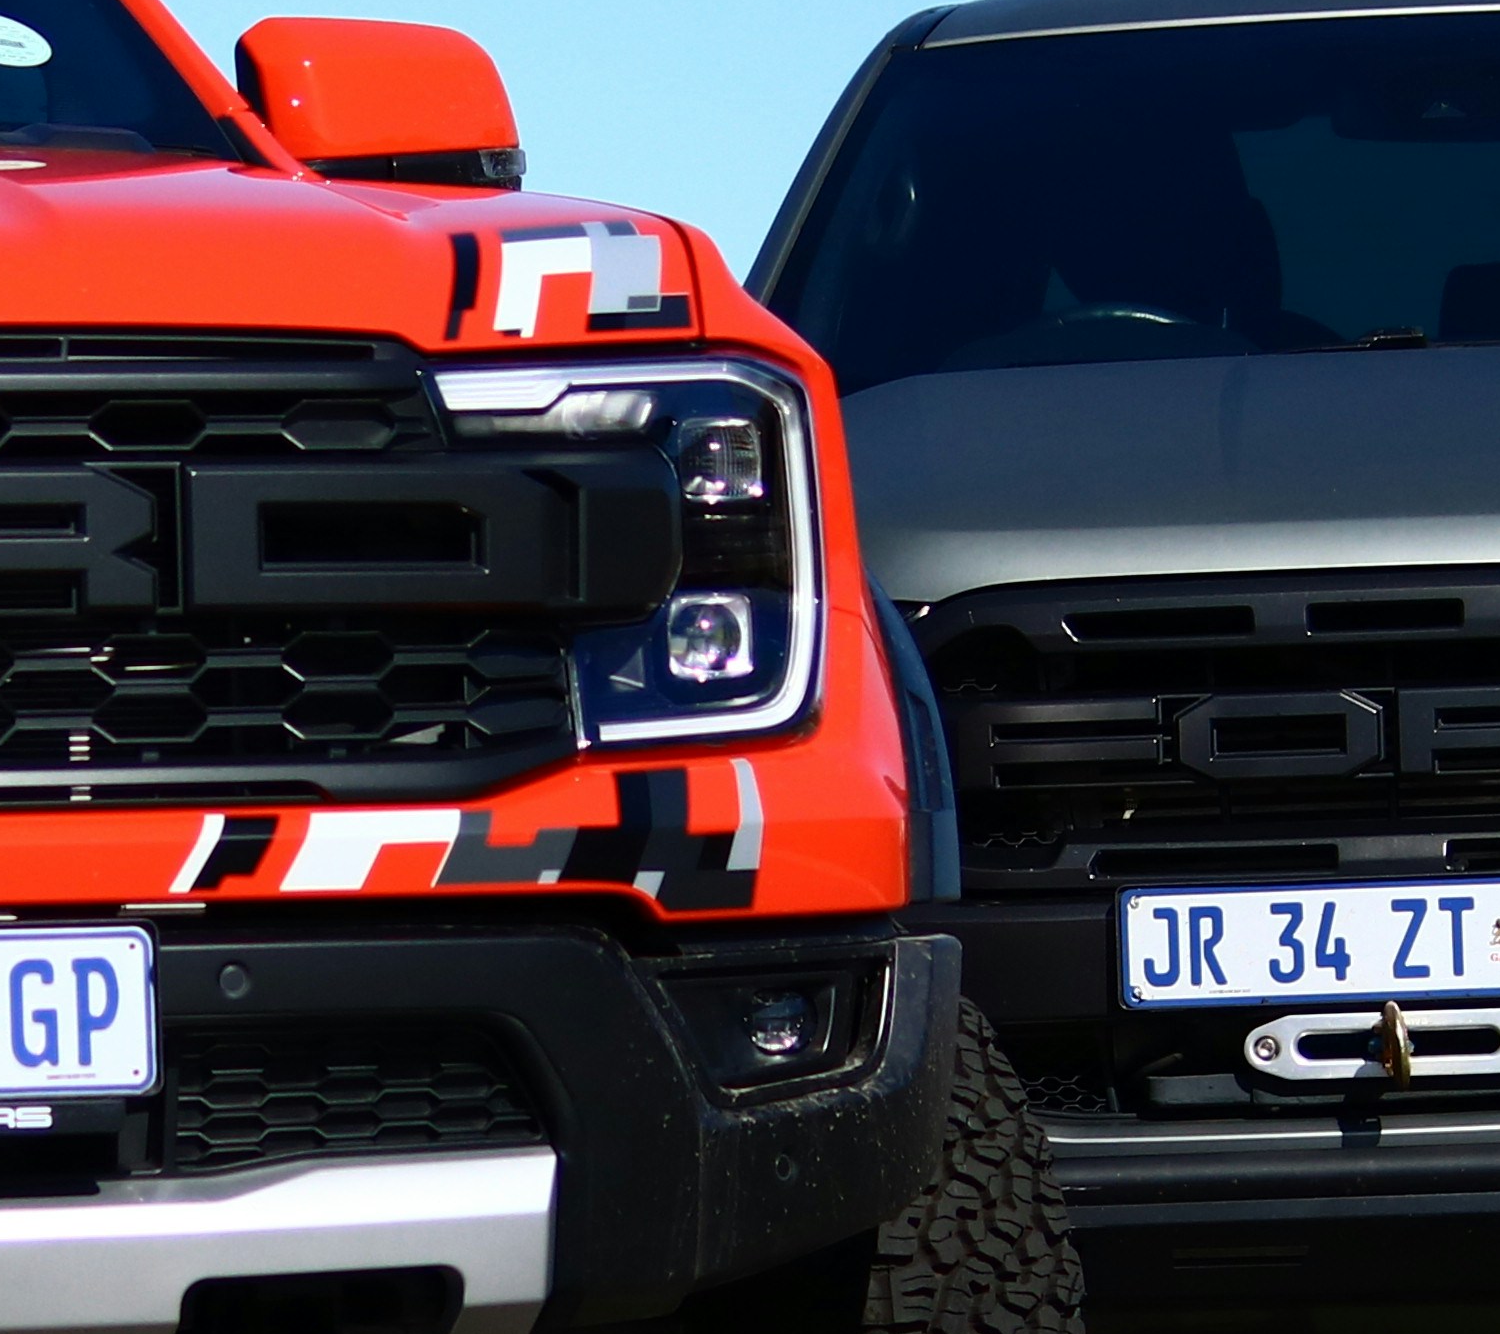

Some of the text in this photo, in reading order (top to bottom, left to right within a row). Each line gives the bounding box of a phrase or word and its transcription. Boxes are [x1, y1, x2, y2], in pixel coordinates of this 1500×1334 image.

[1143, 906, 1228, 988] JR
[1269, 901, 1351, 984] 34
[1391, 897, 1475, 979] ZT
[9, 957, 120, 1068] GP
